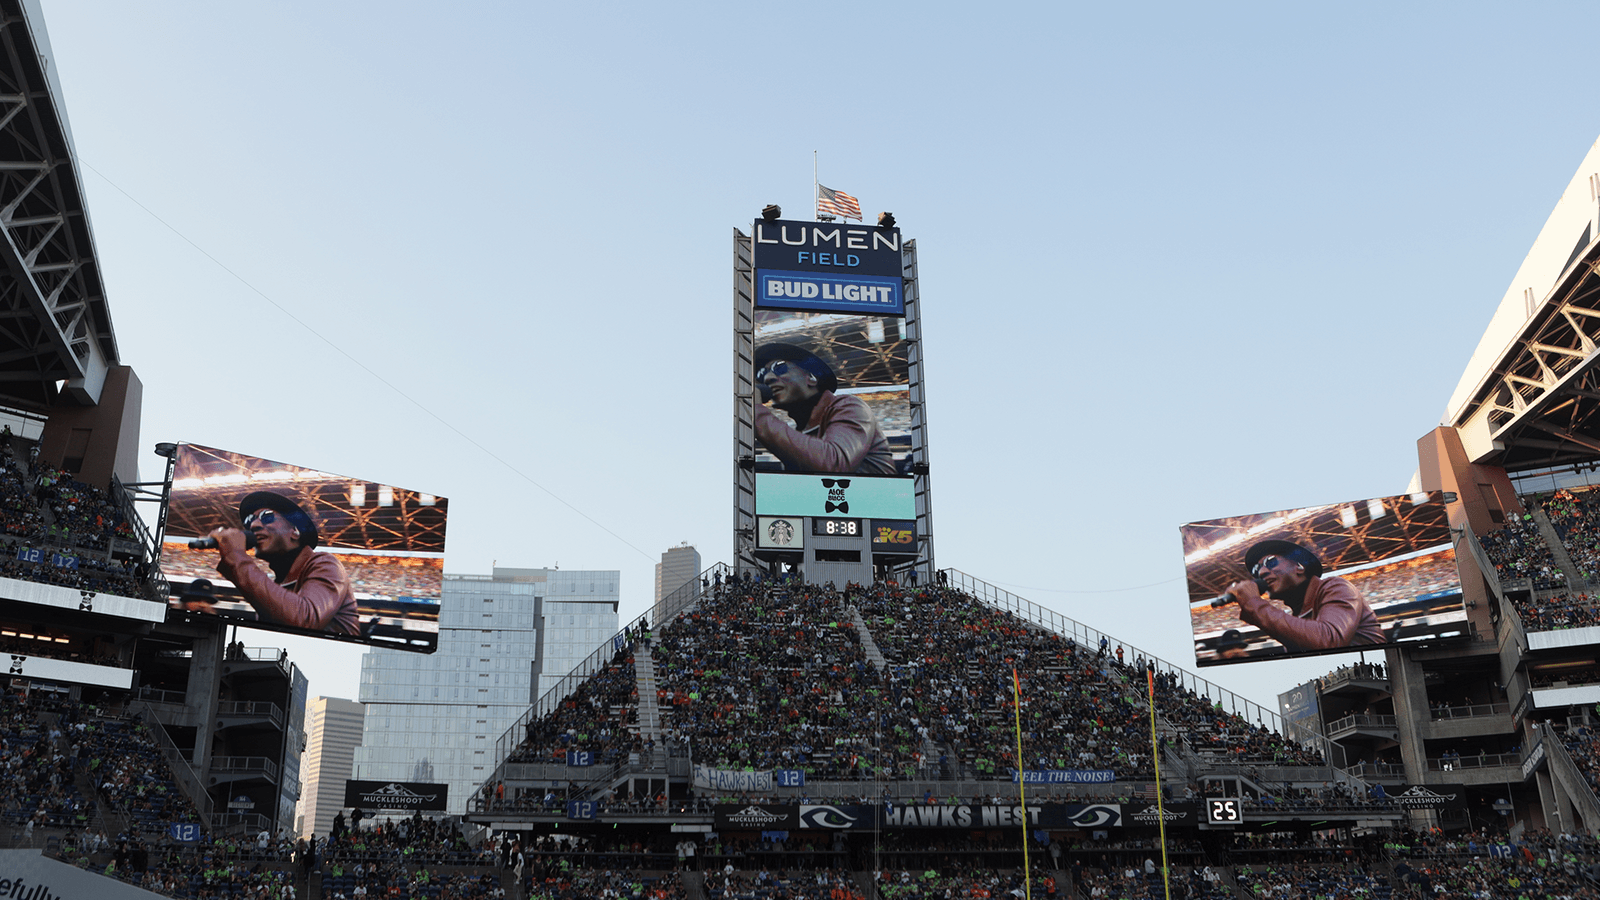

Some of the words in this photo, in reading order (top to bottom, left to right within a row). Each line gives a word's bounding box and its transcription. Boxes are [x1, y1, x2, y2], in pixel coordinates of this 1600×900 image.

[757, 224, 898, 251] LUMEN
[798, 251, 860, 267] FIELD
[768, 280, 819, 298] BUD
[822, 283, 892, 303] LIGHT
[826, 520, 857, 535] 8:38
[23, 549, 40, 563] 12
[573, 751, 590, 766] 12
[747, 772, 772, 792] NEST
[783, 769, 799, 785] 12
[1013, 771, 1045, 783] FEEL
[1047, 771, 1072, 783] THE
[1075, 771, 1114, 783] NOISE!
[363, 795, 423, 805] MUCKLESHOOT
[573, 802, 592, 819] 12
[885, 805, 973, 827] HAWKS
[981, 805, 1042, 826] NEST
[1212, 801, 1237, 821] 25
[175, 824, 194, 841] 12
[1495, 845, 1513, 860] 12
